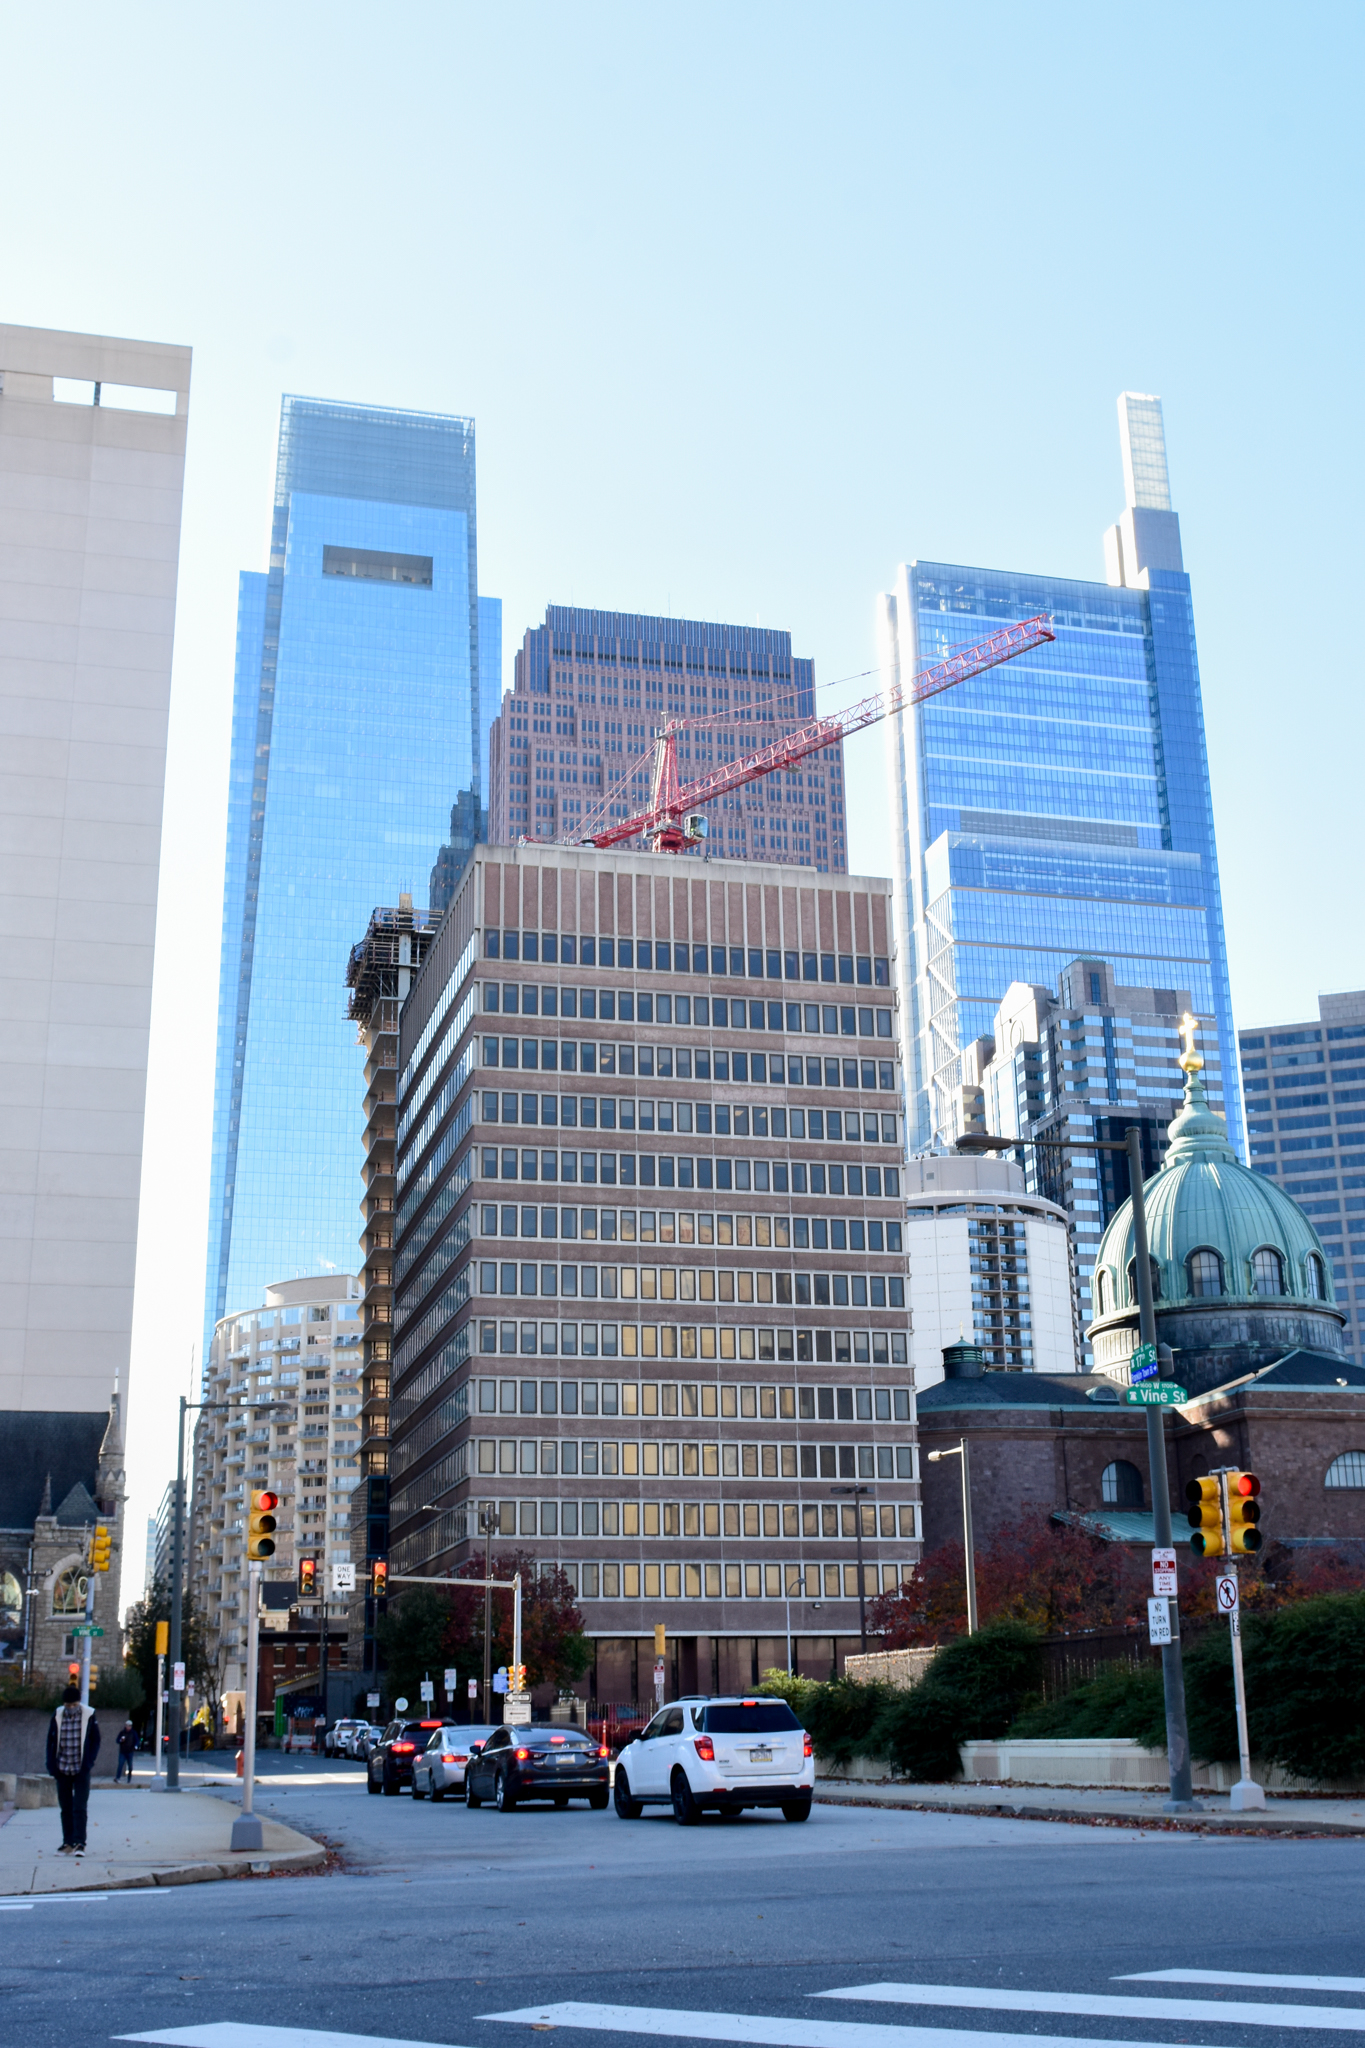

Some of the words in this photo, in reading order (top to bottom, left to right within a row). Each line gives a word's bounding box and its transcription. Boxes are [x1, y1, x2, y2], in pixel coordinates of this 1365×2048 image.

[1149, 1350, 1156, 1362] St
[1140, 1389, 1168, 1402] Vine
[1173, 1390, 1186, 1402] St
[1154, 1602, 1162, 1612] NO
[1152, 1615, 1167, 1625] TURN
[1151, 1629, 1158, 1637] ON
[1159, 1627, 1169, 1636] RED
